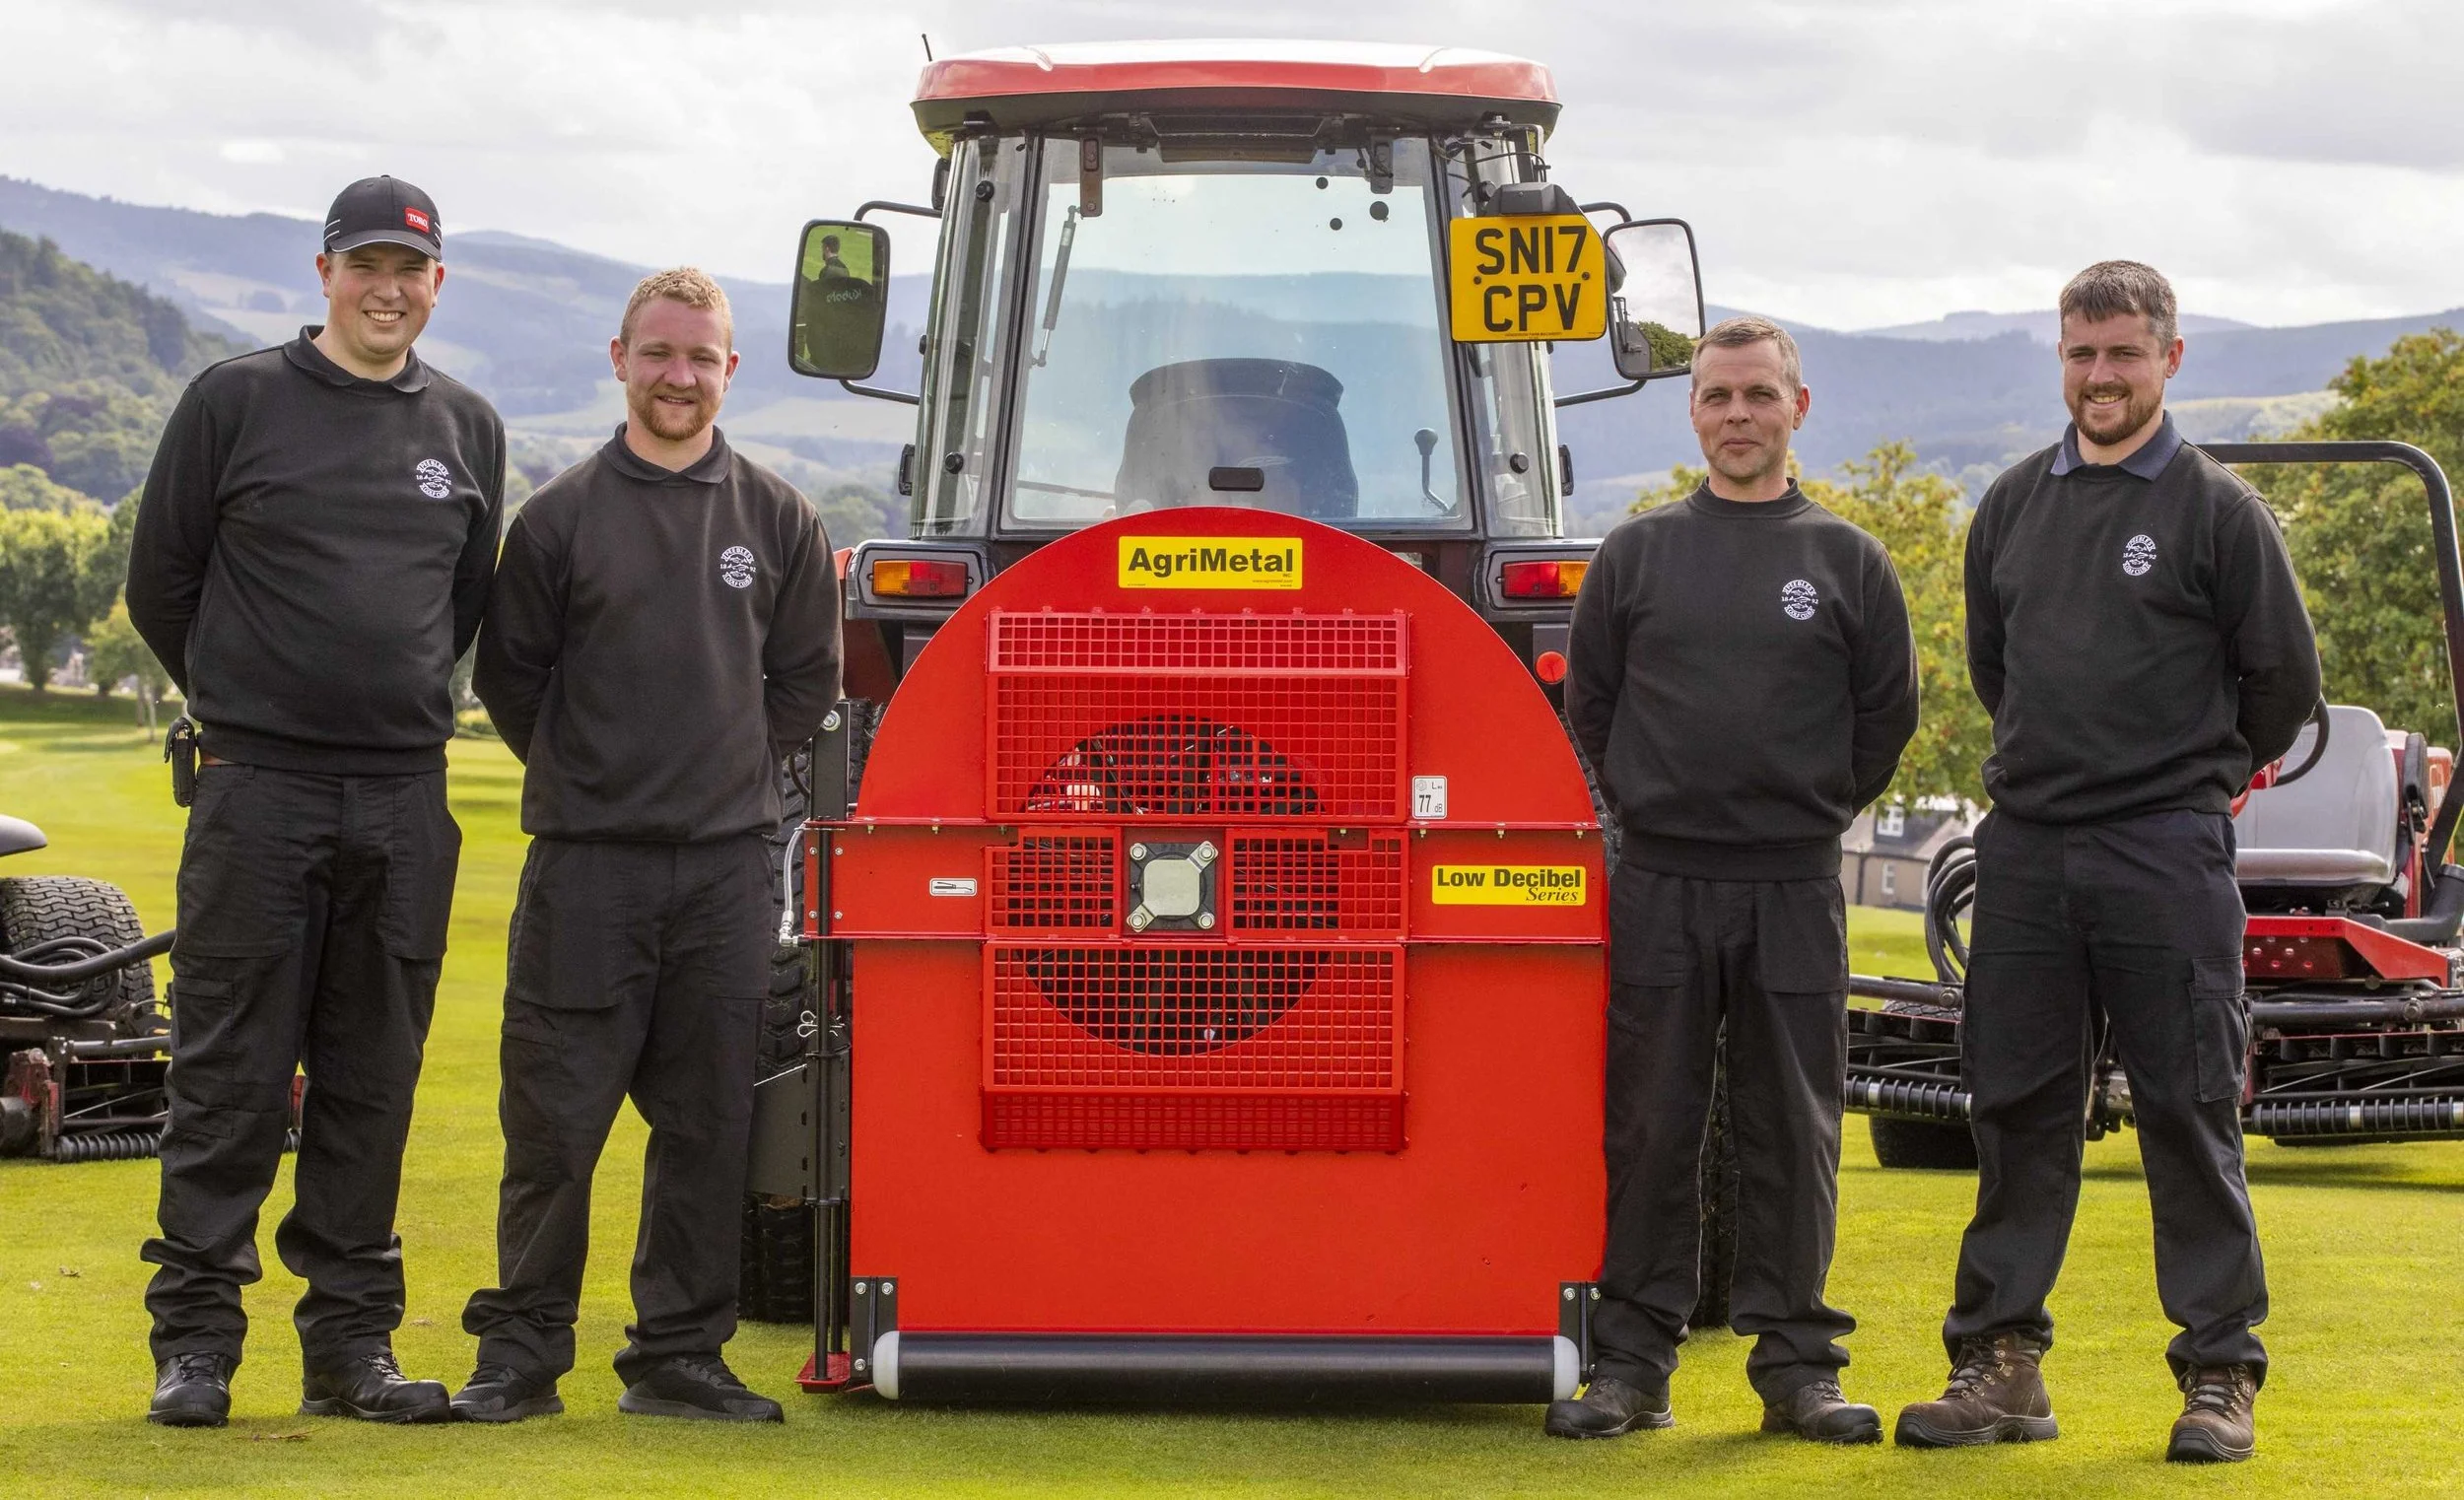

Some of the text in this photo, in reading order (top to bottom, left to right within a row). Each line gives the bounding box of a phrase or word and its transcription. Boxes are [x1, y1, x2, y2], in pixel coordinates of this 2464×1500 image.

[407, 213, 428, 227] TORO
[1475, 226, 1587, 275] SN17
[1483, 283, 1581, 332] CPV
[1129, 547, 1293, 578] AgriMetal
[1419, 794, 1443, 812] 77 dB
[1437, 867, 1581, 887] Low Decibel
[1526, 887, 1578, 901] Series
